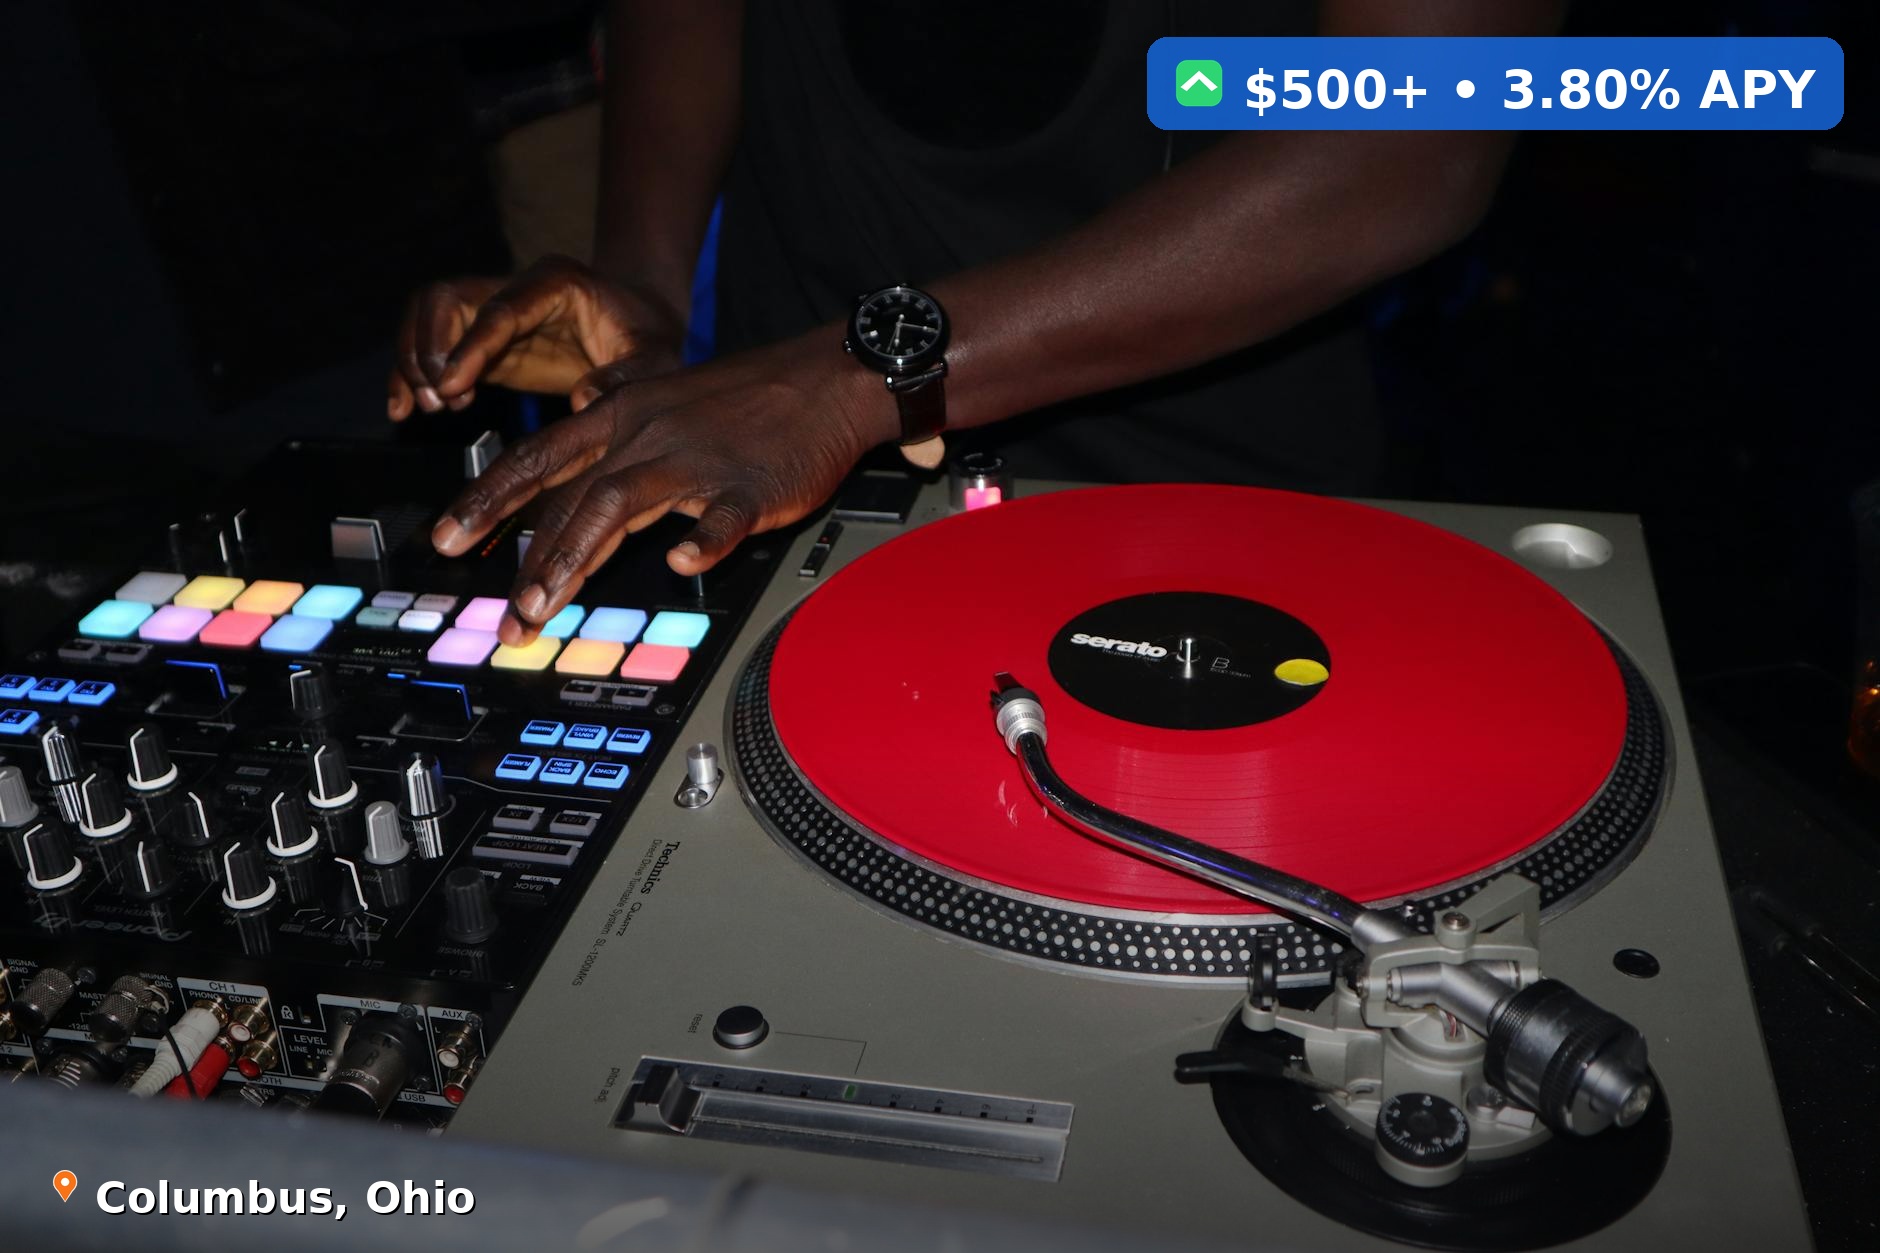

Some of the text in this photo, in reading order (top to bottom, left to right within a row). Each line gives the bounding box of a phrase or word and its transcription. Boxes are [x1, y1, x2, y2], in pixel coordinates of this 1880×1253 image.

[1070, 632, 1167, 659] serato
[572, 731, 594, 739] VINYL
[504, 759, 531, 768] FLANGER
[548, 766, 572, 775] BACK
[645, 839, 662, 857] Direct
[635, 859, 652, 876] Drive
[641, 841, 680, 894] Technics
[512, 882, 544, 892] BACK
[616, 877, 642, 907] Turntable
[601, 908, 623, 935] System
[70, 919, 193, 943] Pioneer
[437, 946, 484, 959] BROWSE
[7, 958, 39, 968] SIGNAL
[10, 966, 29, 974] GND
[154, 980, 173, 989] GND
[209, 981, 236, 993] CH 1
[189, 990, 219, 1000] PHONO
[229, 995, 262, 1005] CD/LIN
[360, 1000, 381, 1010] MIC
[441, 1010, 463, 1019] AUX
[688, 1013, 703, 1034] reset
[293, 1034, 328, 1046] LEVEL
[289, 1044, 308, 1054] LINE
[316, 1047, 333, 1058] MIC
[604, 1067, 620, 1088] pitch
[404, 1094, 426, 1103] USB
